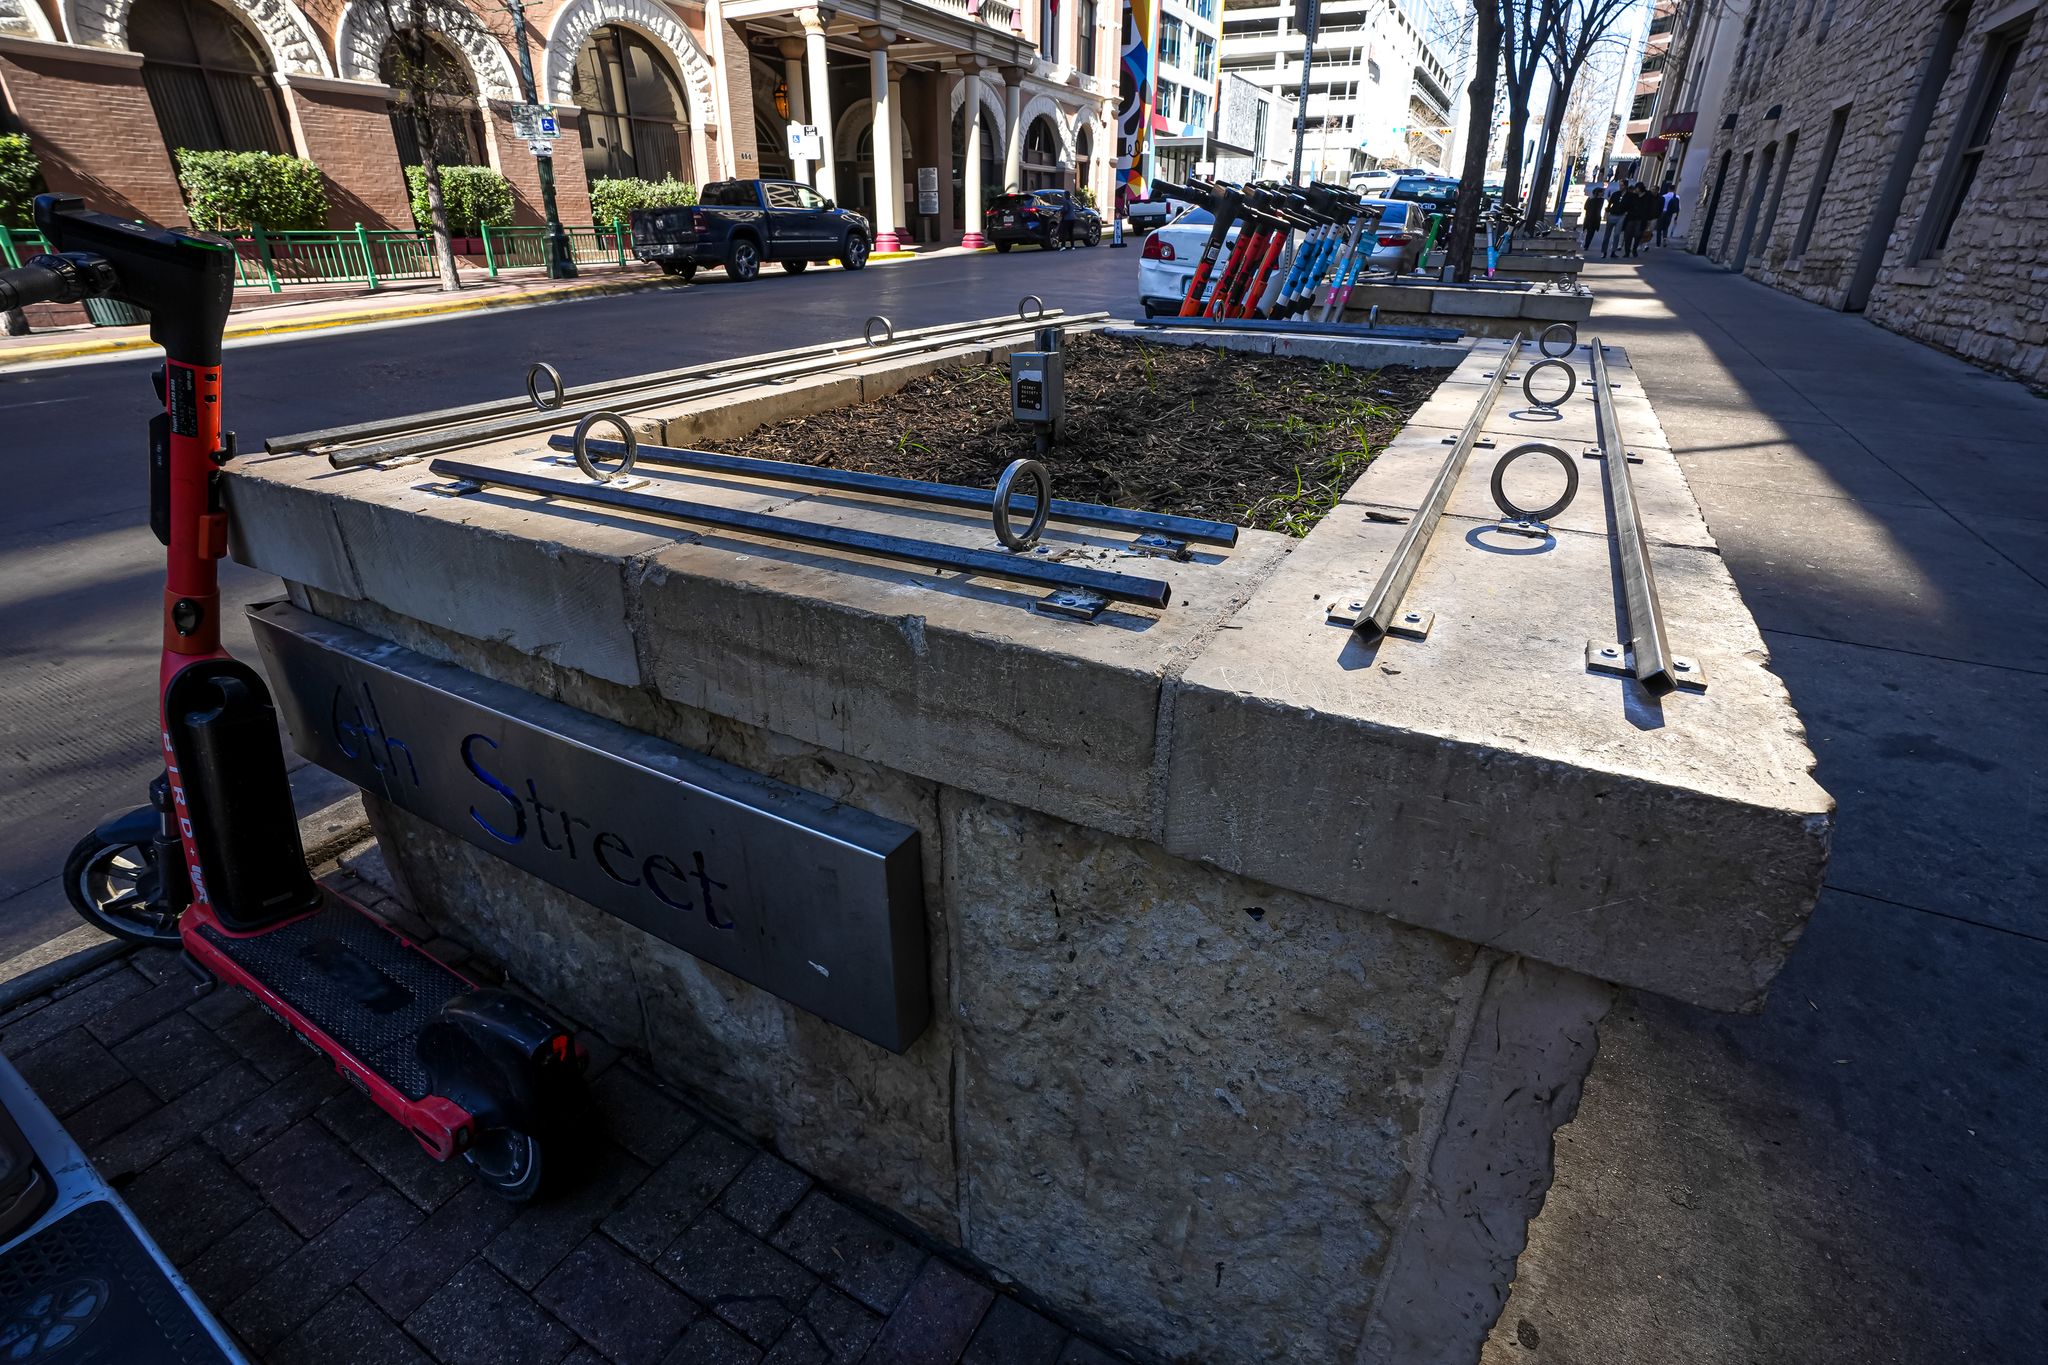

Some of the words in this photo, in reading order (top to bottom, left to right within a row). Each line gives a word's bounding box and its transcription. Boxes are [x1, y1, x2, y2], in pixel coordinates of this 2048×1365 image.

[163, 732, 194, 839] BIRD
[332, 682, 419, 786] 6th
[460, 733, 734, 930] Street
